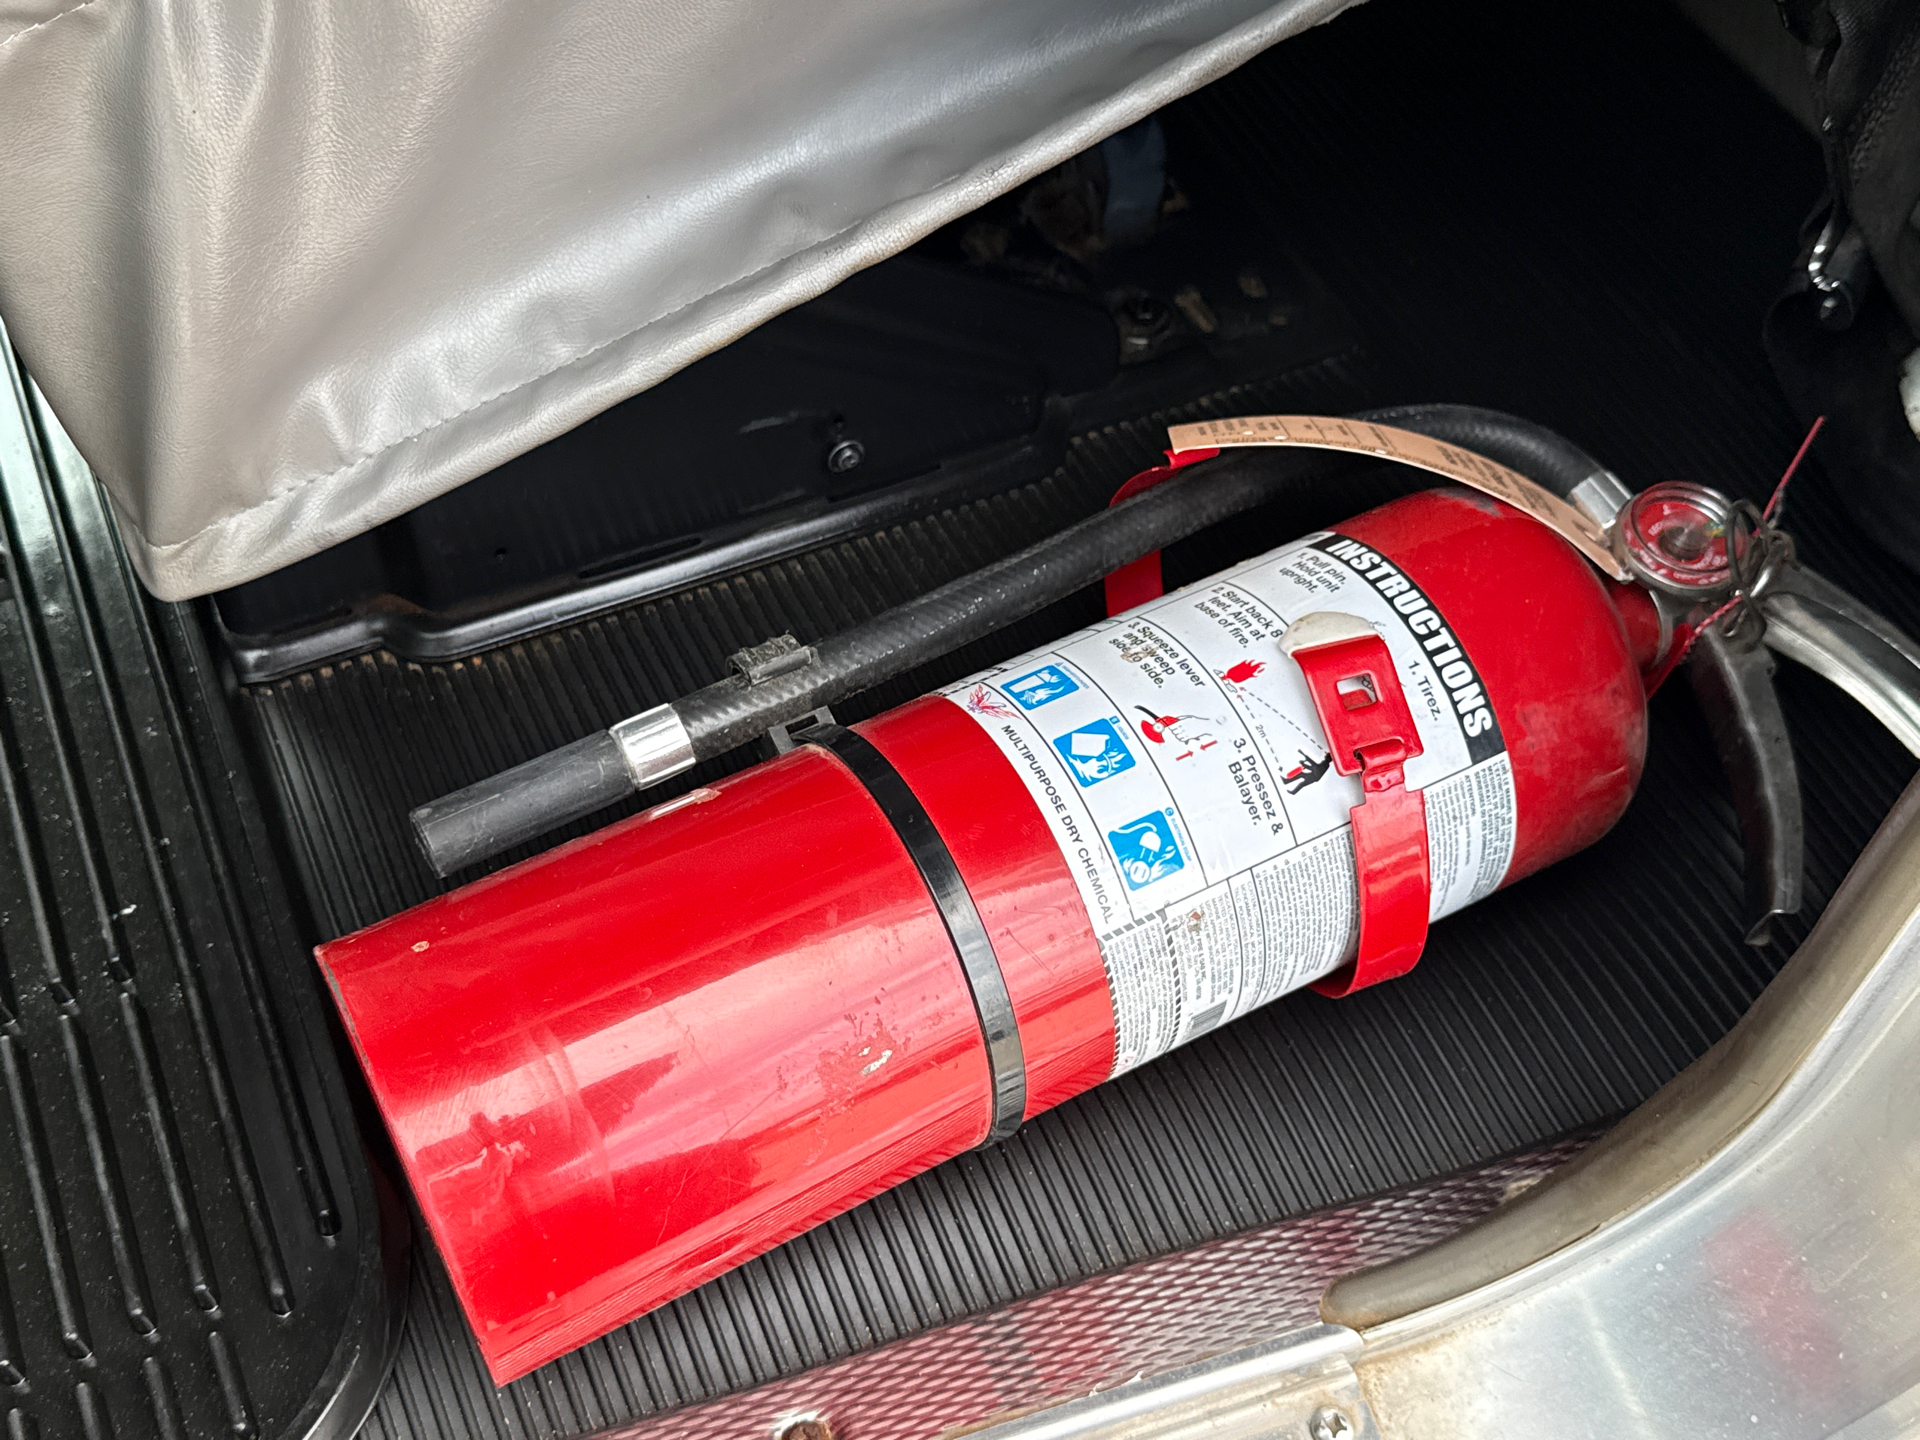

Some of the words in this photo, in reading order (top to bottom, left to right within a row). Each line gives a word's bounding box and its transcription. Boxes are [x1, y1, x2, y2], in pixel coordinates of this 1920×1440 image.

[1279, 567, 1319, 593] upright.
[1292, 561, 1321, 577] Hold
[1317, 575, 1340, 593] unit
[1306, 555, 1331, 570] Pull
[1326, 566, 1346, 585] pin.
[1194, 601, 1220, 619] base
[1218, 618, 1235, 628] of
[1229, 627, 1249, 648] fire.
[1208, 596, 1232, 612] feet.
[1227, 611, 1253, 629] Aim
[1249, 629, 1266, 641] at
[1222, 591, 1249, 607] Start
[1245, 605, 1274, 630] back
[1270, 629, 1284, 638] 8
[1123, 632, 1147, 647] and
[1142, 644, 1176, 675] sweep
[1137, 626, 1179, 659] Squeeze
[1176, 658, 1206, 687] lever
[1325, 539, 1493, 738] INSTRUCTIONS
[1109, 638, 1131, 653] side
[1129, 651, 1142, 662] to
[1140, 662, 1164, 689] side.
[1408, 660, 1420, 675] 1.
[1417, 676, 1443, 721] Tirez.
[1255, 724, 1267, 738] 2m
[1228, 761, 1262, 826] Balayer.
[1233, 738, 1247, 753] 3.
[1242, 755, 1276, 820] Pressez
[1271, 823, 1284, 836] &
[1001, 724, 1067, 814] MULTIPURPOSE
[1061, 815, 1083, 844] DRY
[1078, 847, 1114, 924] CHEMICAL
